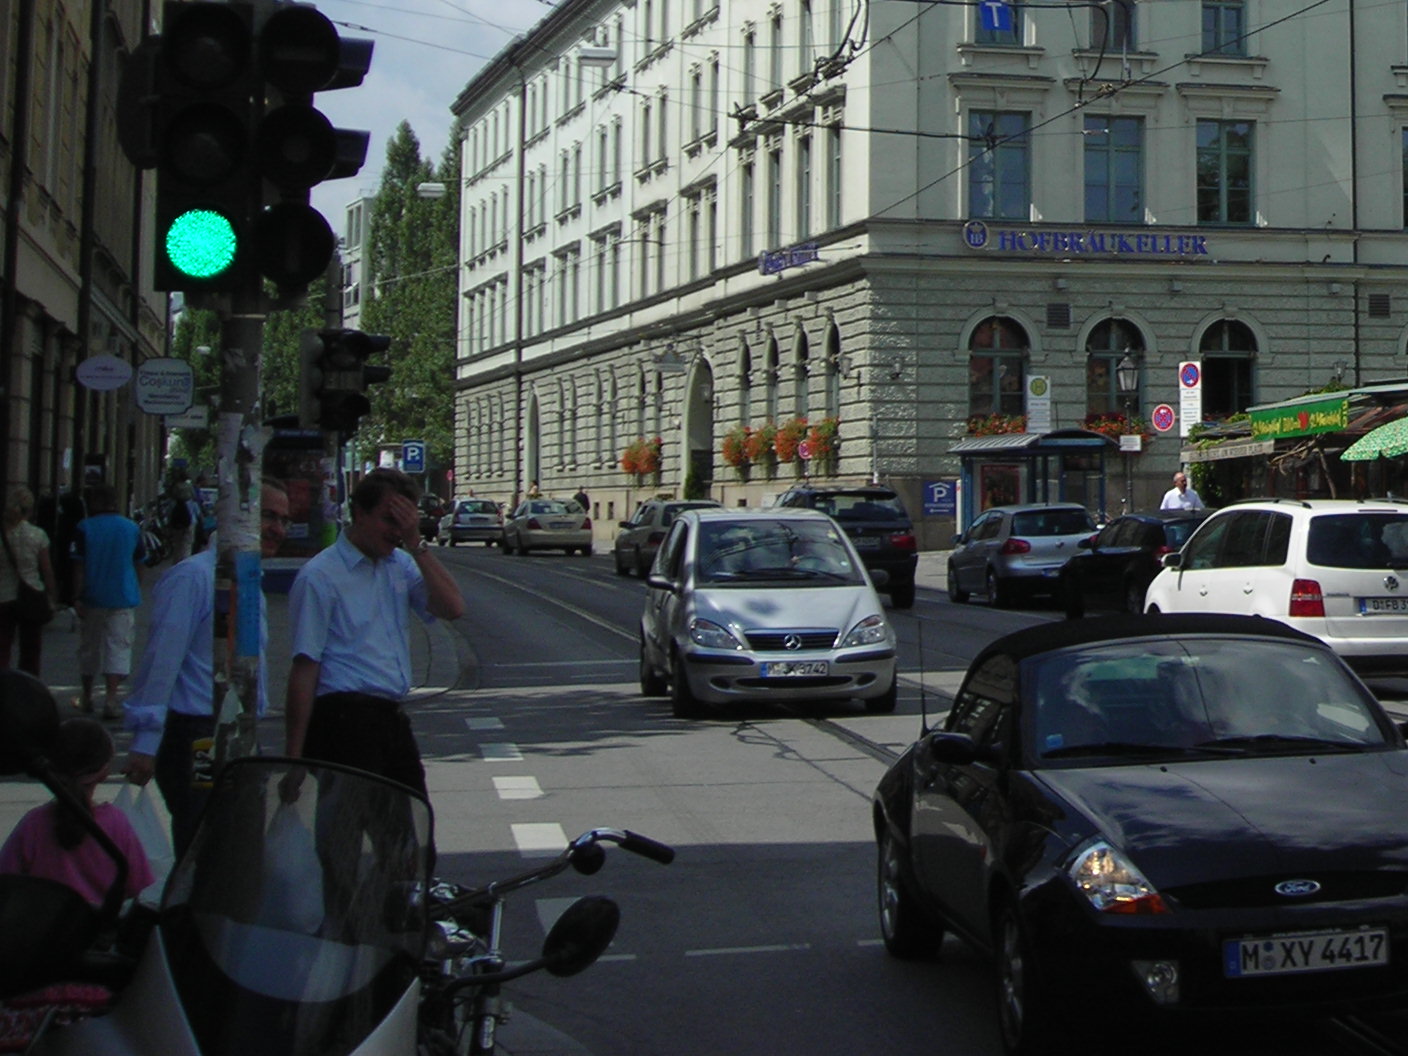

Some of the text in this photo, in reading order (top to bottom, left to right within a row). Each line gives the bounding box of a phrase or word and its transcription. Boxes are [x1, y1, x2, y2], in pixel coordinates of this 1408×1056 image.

[999, 230, 1209, 255] HOFBRÄUKELLER
[407, 446, 419, 461] P
[934, 487, 948, 503] P
[1242, 934, 1384, 970] M XY 4417
